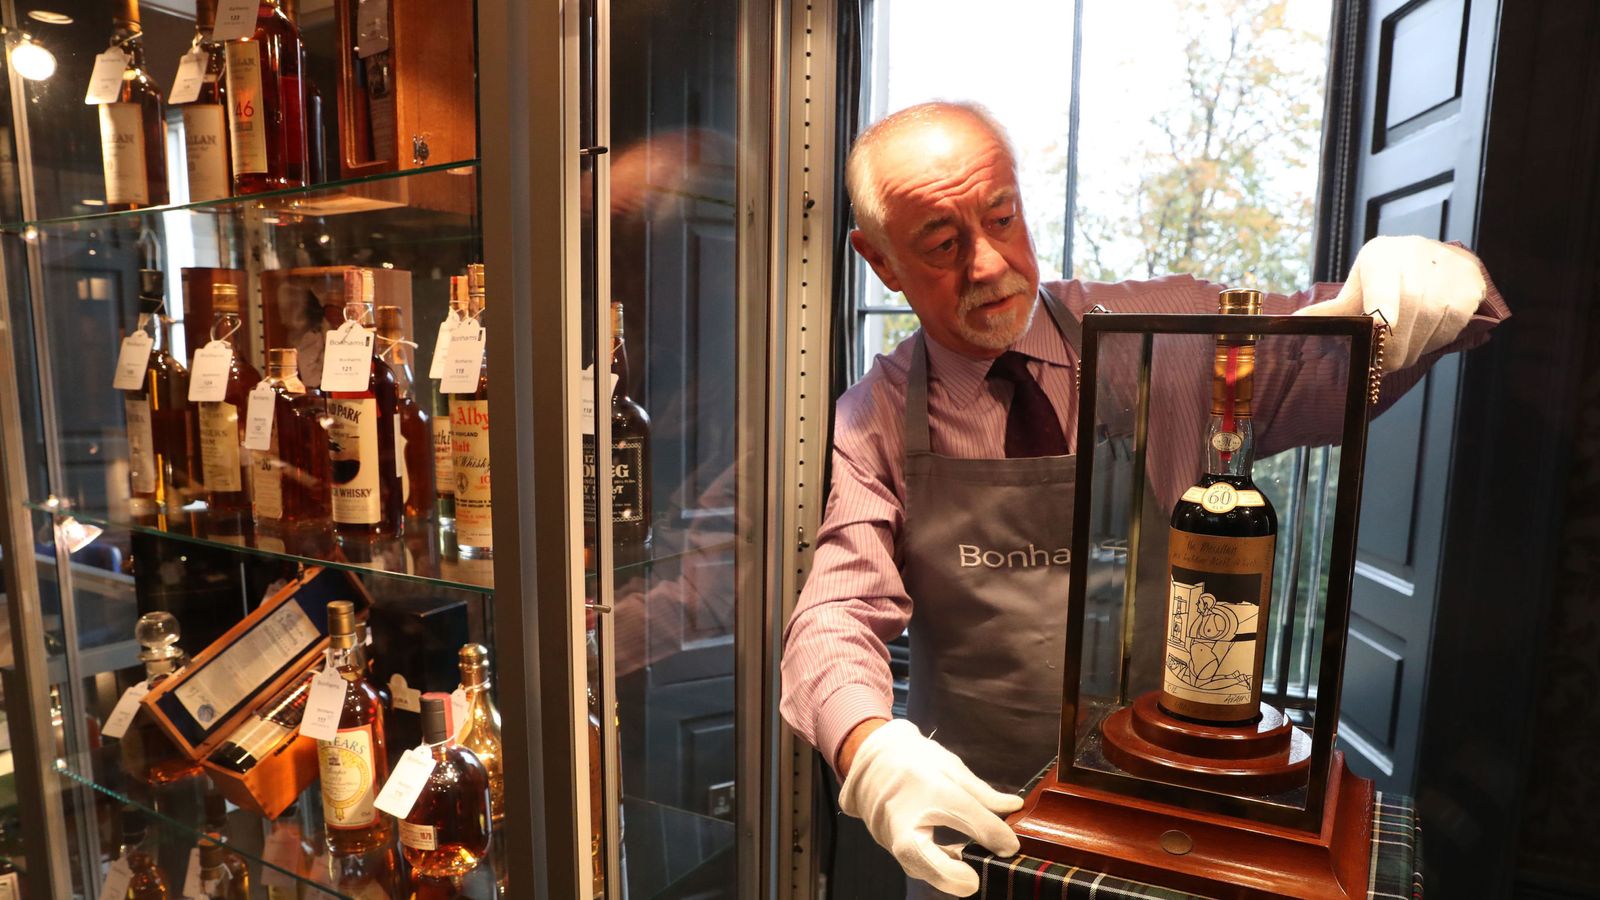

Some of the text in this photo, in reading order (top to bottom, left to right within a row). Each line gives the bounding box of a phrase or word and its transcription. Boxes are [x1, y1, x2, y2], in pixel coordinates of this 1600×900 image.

[336, 404, 362, 424] PARK
[339, 488, 372, 498] WHISKY
[1208, 490, 1232, 505] 60
